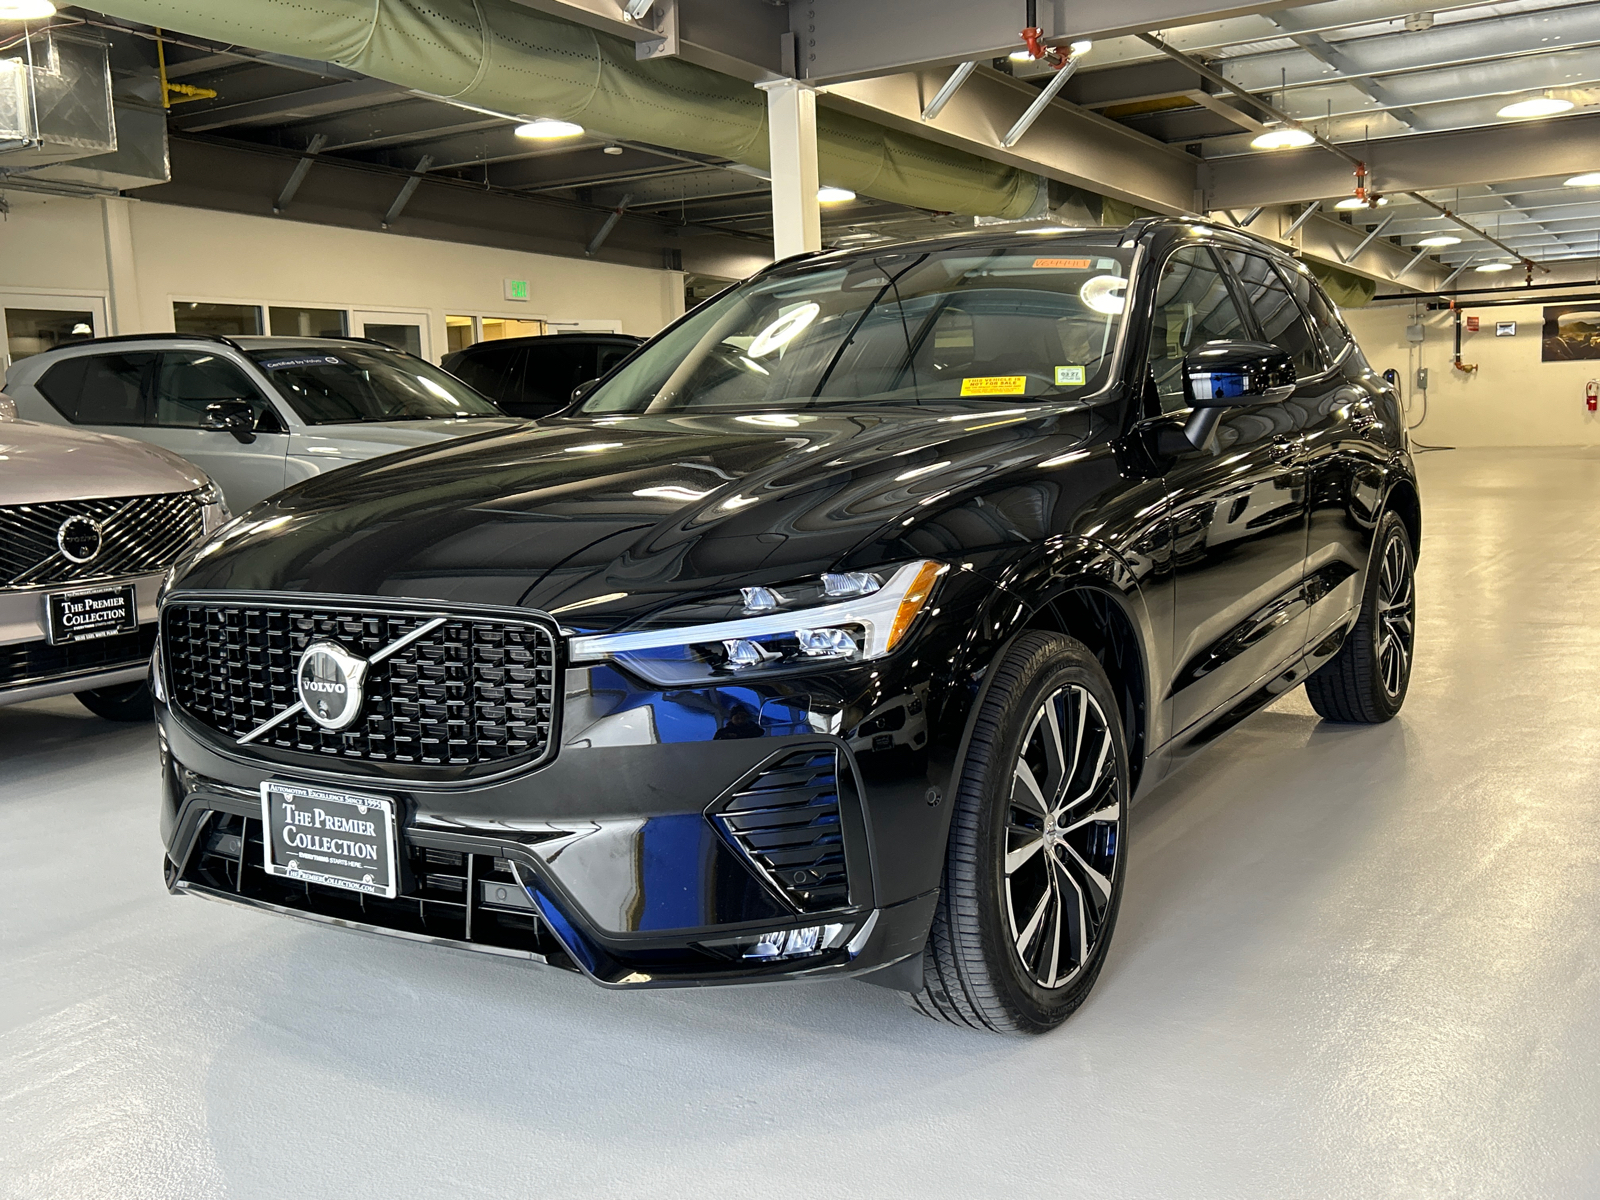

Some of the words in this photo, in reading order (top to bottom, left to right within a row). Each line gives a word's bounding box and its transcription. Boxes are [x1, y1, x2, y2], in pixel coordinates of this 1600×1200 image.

[61, 602, 84, 614] THE
[85, 597, 125, 611] PREMIER
[63, 608, 126, 627] COLLECTION
[302, 680, 346, 694] VOLVO
[270, 784, 308, 797] AUTOMOTIVE
[308, 790, 344, 802] EXCELLENCE
[345, 795, 363, 804] SINCE
[364, 798, 381, 809] 1995
[282, 803, 313, 827] THE
[313, 808, 376, 837] PREMIER
[283, 825, 378, 860] COLLECTION
[298, 852, 330, 863] EVERYTHING
[330, 857, 347, 866] STARTS
